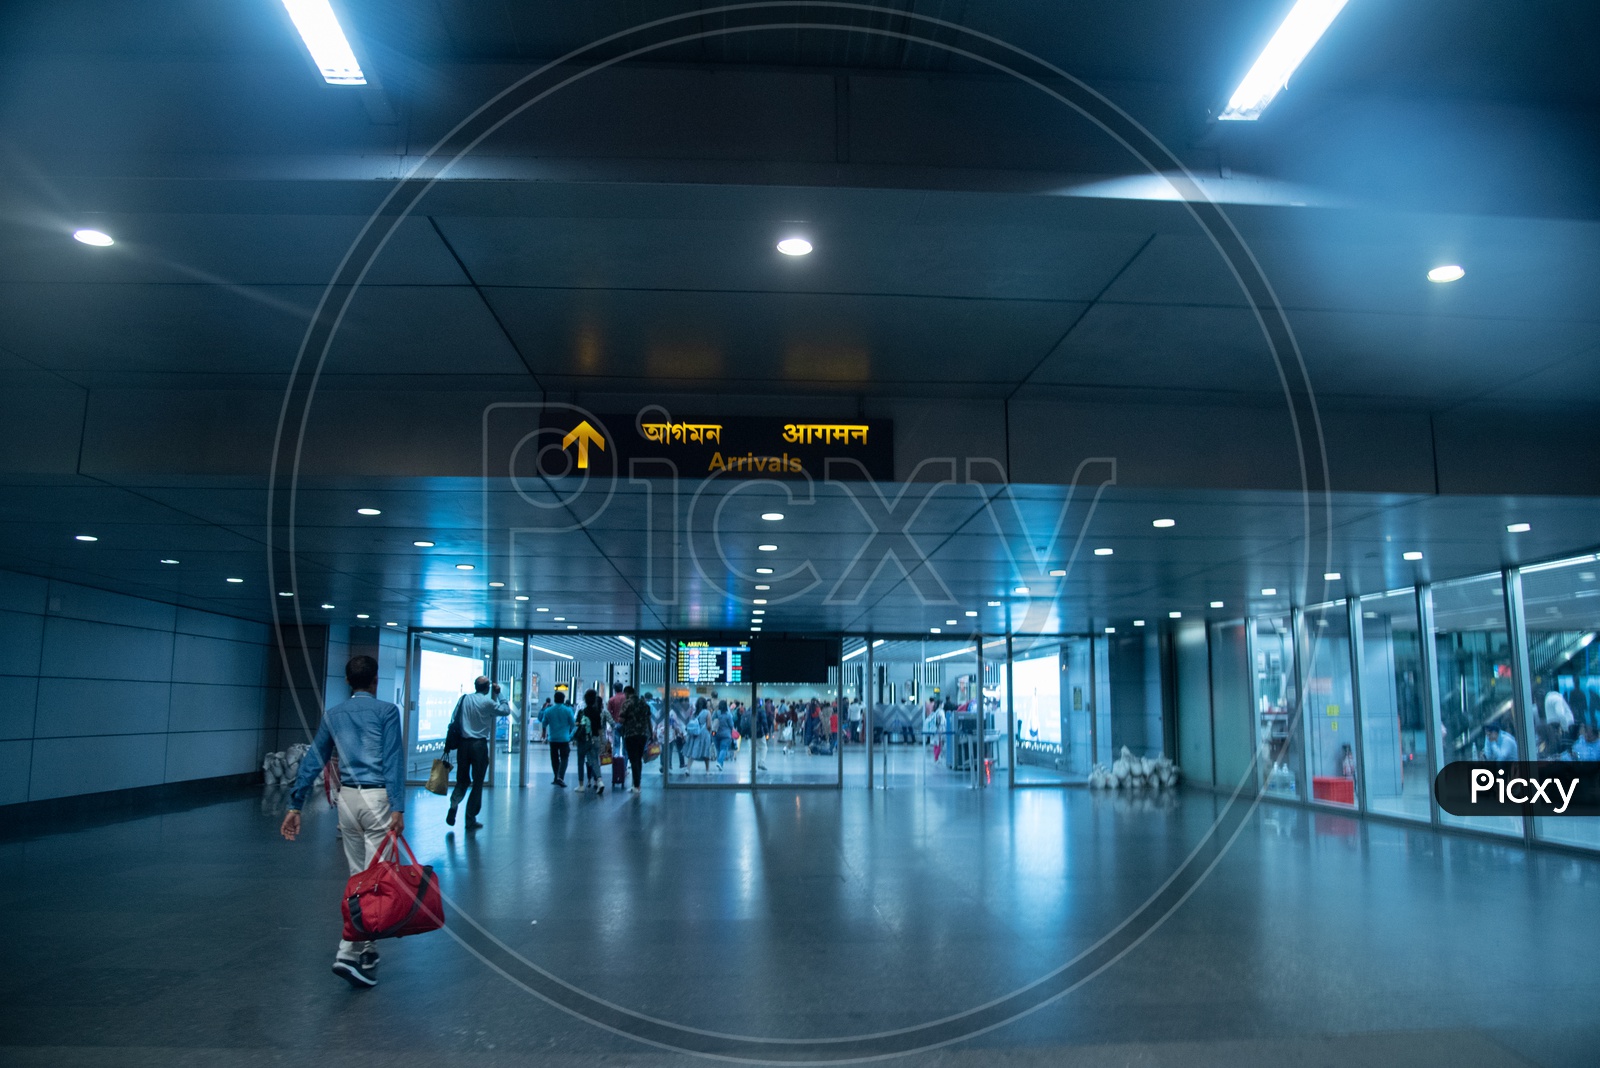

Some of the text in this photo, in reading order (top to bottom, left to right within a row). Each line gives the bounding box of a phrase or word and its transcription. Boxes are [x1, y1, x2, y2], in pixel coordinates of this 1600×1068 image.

[641, 421, 723, 446] আগমন
[782, 423, 869, 446] आगमन
[708, 451, 803, 473] Arrivals
